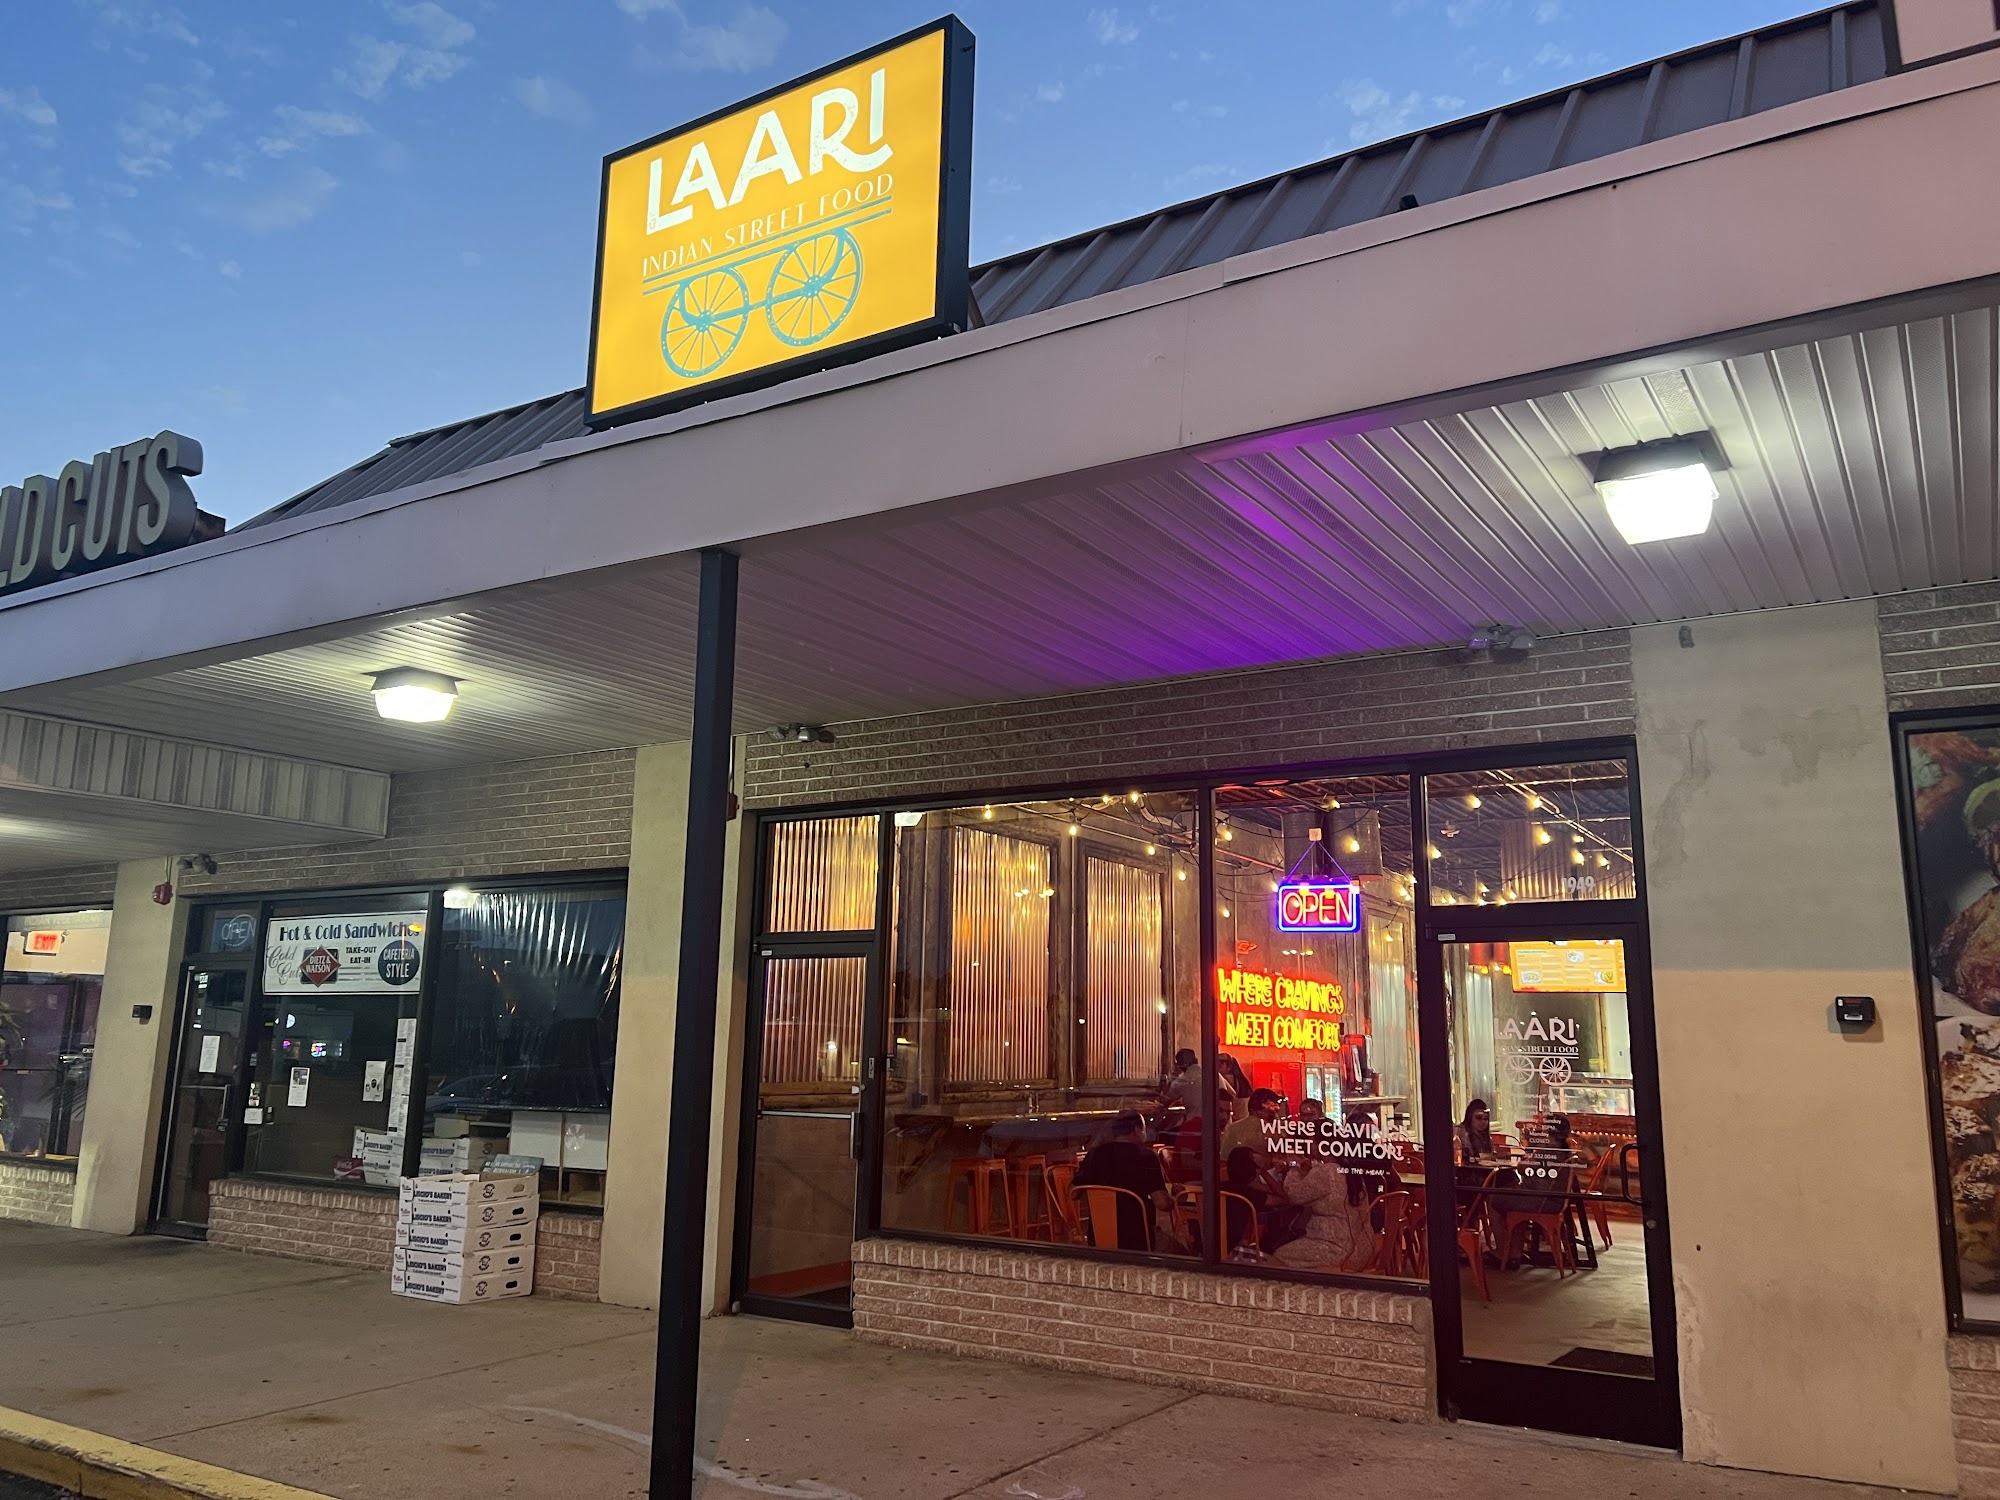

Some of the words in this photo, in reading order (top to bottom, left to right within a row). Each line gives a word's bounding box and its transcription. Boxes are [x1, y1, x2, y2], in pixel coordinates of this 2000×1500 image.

[645, 67, 894, 236] LAARI
[642, 236, 713, 277] INDIAN
[724, 203, 805, 249] STREET
[819, 173, 893, 215] FOOD
[1561, 875, 1595, 894] 1949
[1282, 891, 1353, 925] OPEN
[221, 920, 257, 941] OPEN
[279, 926, 300, 942] Hot
[303, 926, 312, 940] &
[315, 924, 342, 940] Cold
[33, 933, 58, 950] EXIT
[346, 946, 378, 955] TAKE-OUT
[267, 946, 298, 969] Cold
[310, 956, 326, 964] DIETZ
[350, 957, 371, 965] EAT-IN
[384, 948, 415, 961] CAFETERIA
[305, 964, 331, 974] WATSON
[385, 963, 410, 979] STYLE
[1274, 975, 1344, 1016] CRAVINGS
[1225, 1011, 1271, 1047] MEET
[1273, 1014, 1341, 1053] COMFORT
[1493, 1017, 1578, 1046] LAARI
[1554, 1046, 1579, 1054] FOOD
[1267, 1137, 1314, 1155] MEET
[1318, 1140, 1405, 1161] COMFORT
